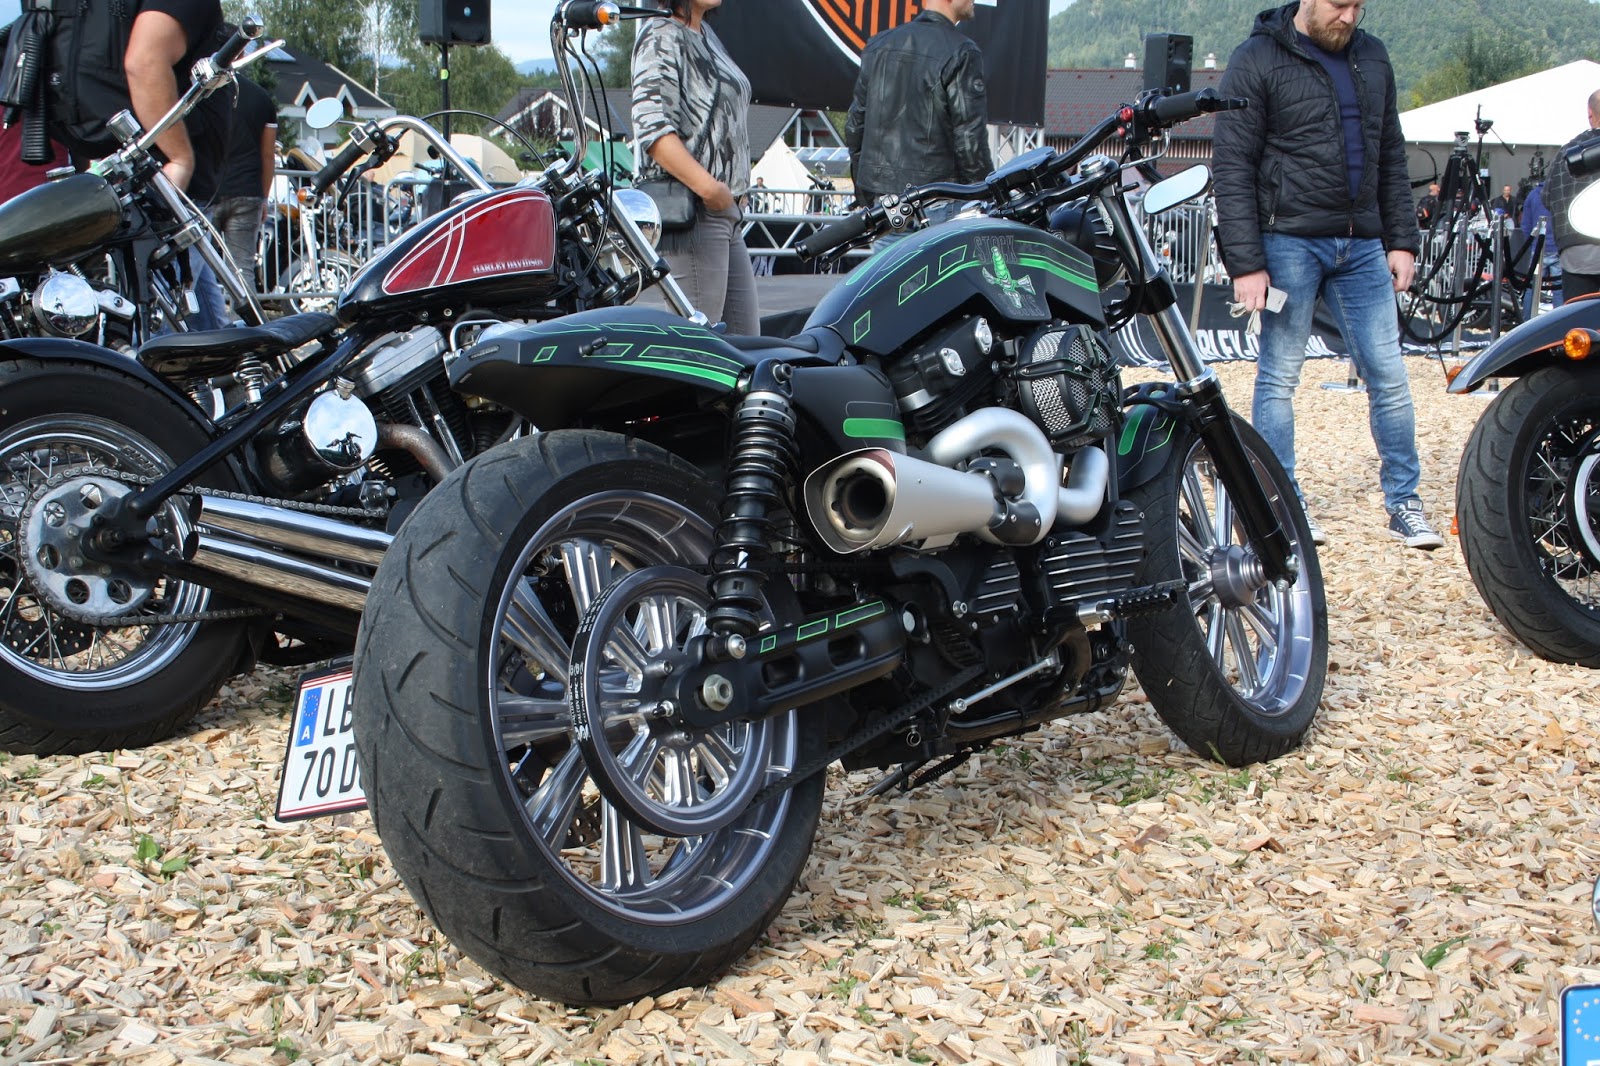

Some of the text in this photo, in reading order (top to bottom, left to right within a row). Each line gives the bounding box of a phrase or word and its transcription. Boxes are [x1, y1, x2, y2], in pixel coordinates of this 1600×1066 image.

[473, 258, 543, 274] HARLEY DAVIDSON
[302, 725, 311, 741] A
